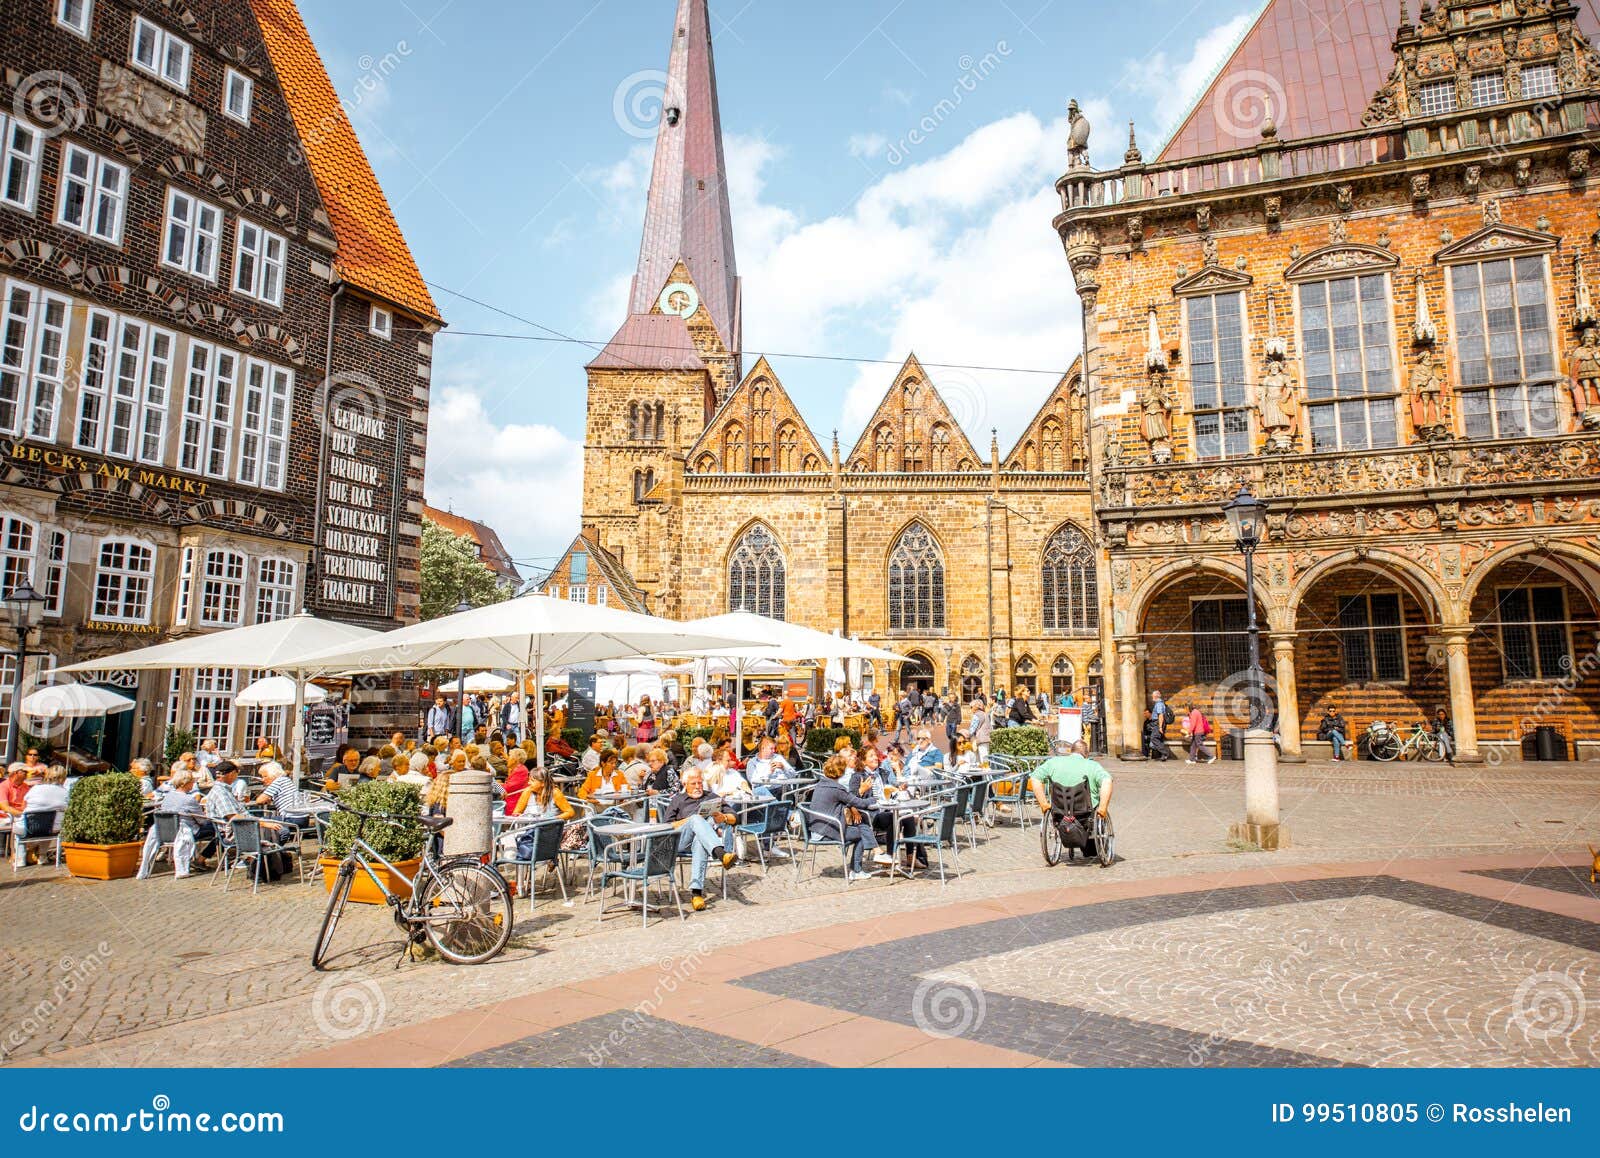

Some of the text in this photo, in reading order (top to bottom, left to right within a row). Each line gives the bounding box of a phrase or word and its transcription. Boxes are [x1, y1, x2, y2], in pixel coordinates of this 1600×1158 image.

[334, 408, 385, 440] GEDENKE
[332, 432, 356, 455] DER
[97, 462, 130, 481] AM
[139, 470, 209, 495] MARKT
[330, 456, 382, 487] BRÜDER,
[329, 480, 373, 507] DIE DAS
[327, 505, 387, 534] SCHICKSAL
[325, 530, 379, 557] UNSERER
[324, 555, 385, 582] TRENNUNG
[87, 621, 160, 634] RESTAURANT
